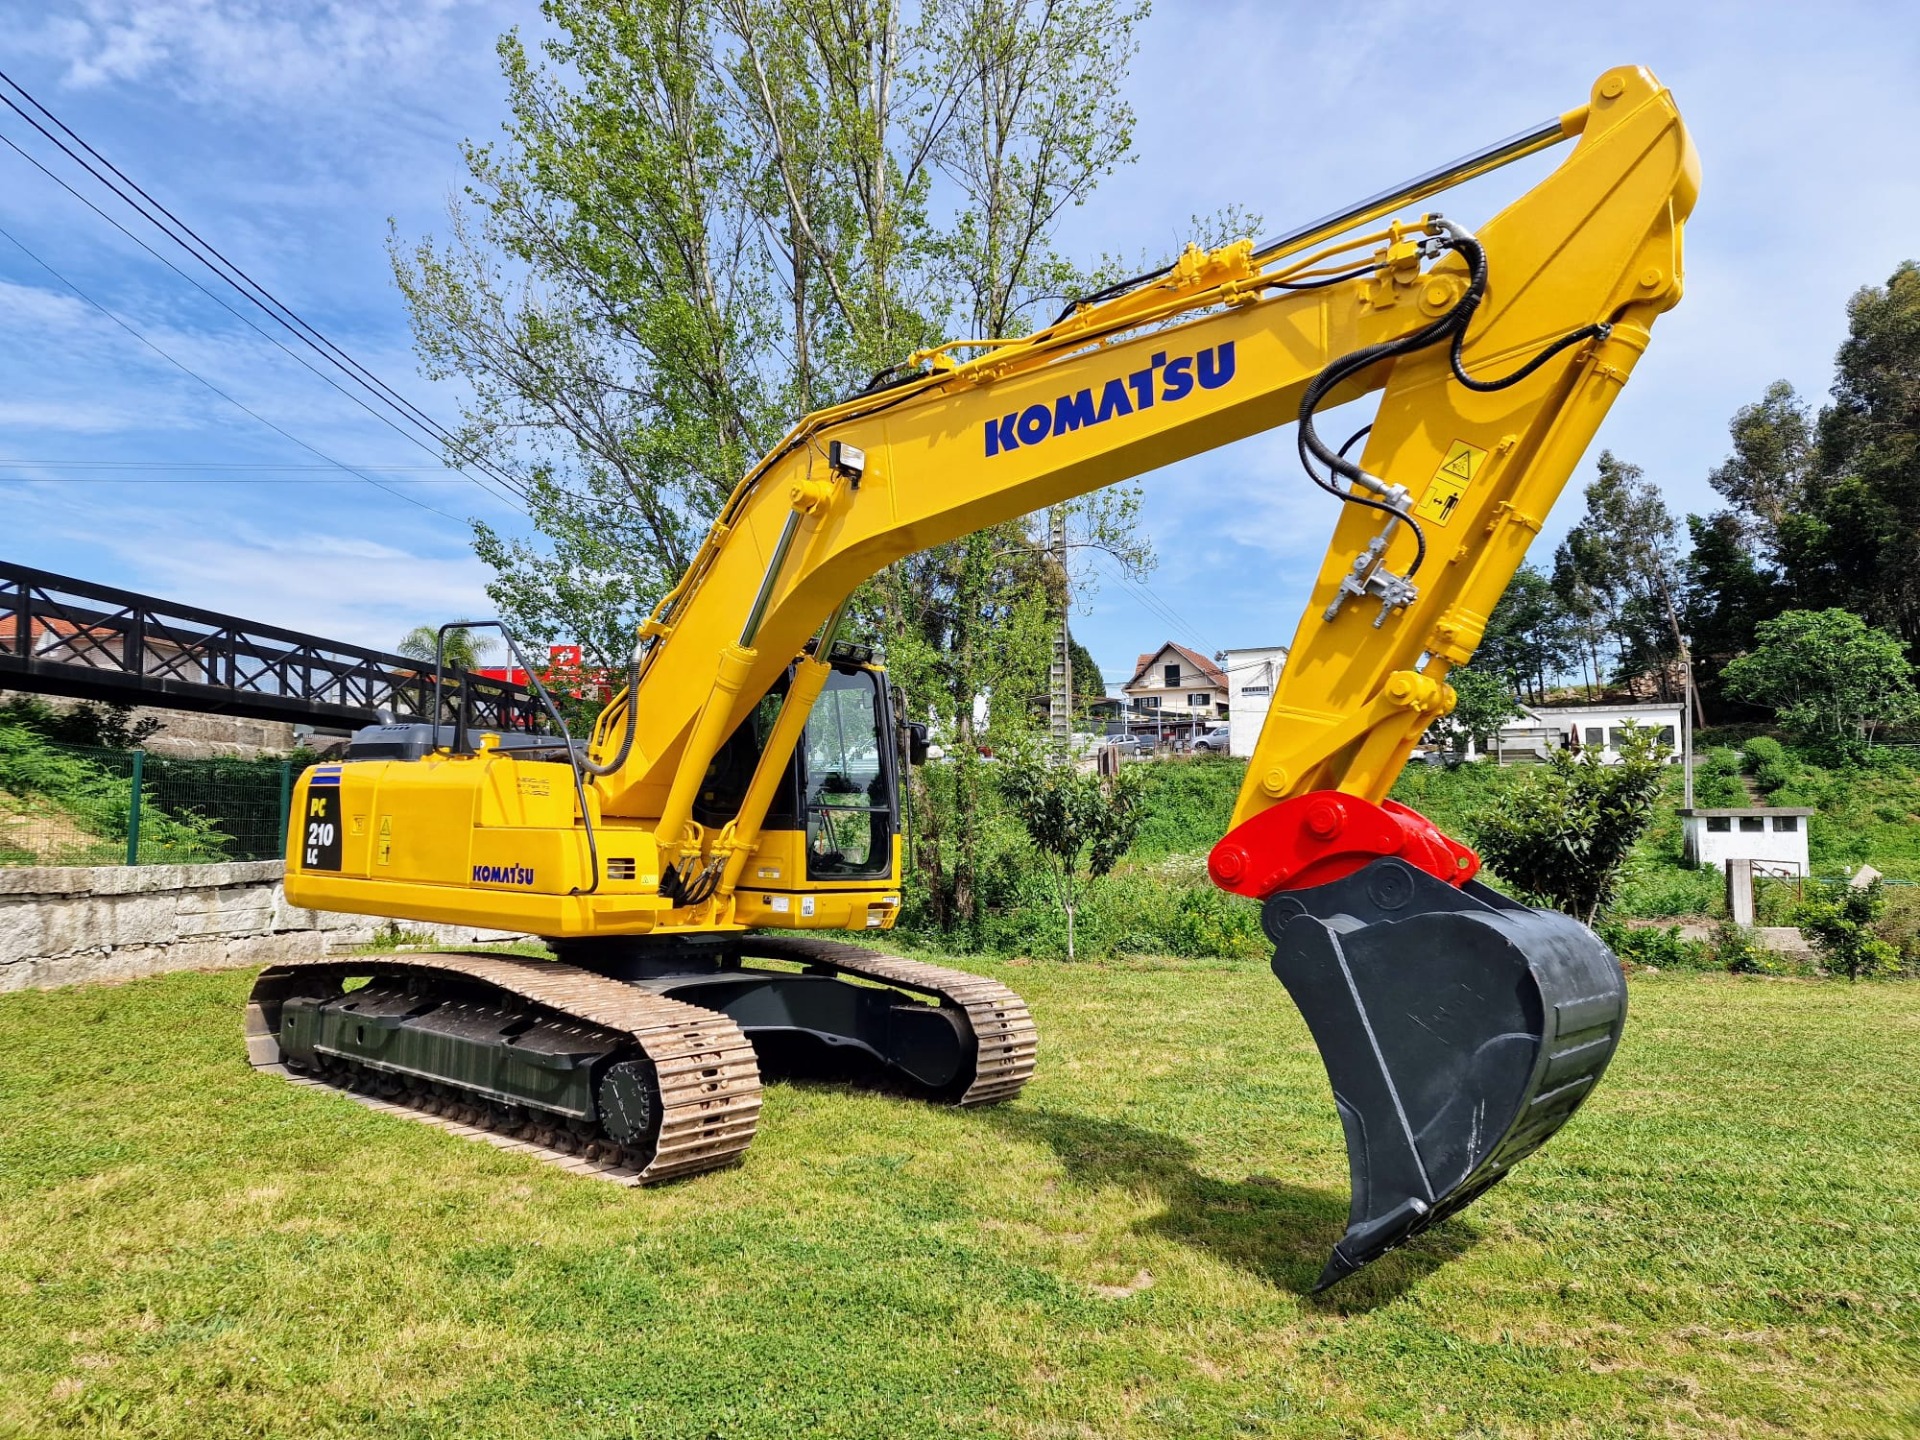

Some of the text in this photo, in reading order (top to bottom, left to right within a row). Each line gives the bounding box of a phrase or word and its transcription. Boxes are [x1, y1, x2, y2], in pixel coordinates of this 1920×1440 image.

[984, 340, 1235, 458] KOMATSU
[310, 798, 326, 817] PC
[308, 822, 334, 846] 210
[306, 848, 318, 865] LC
[472, 862, 534, 885] KOMATSU
